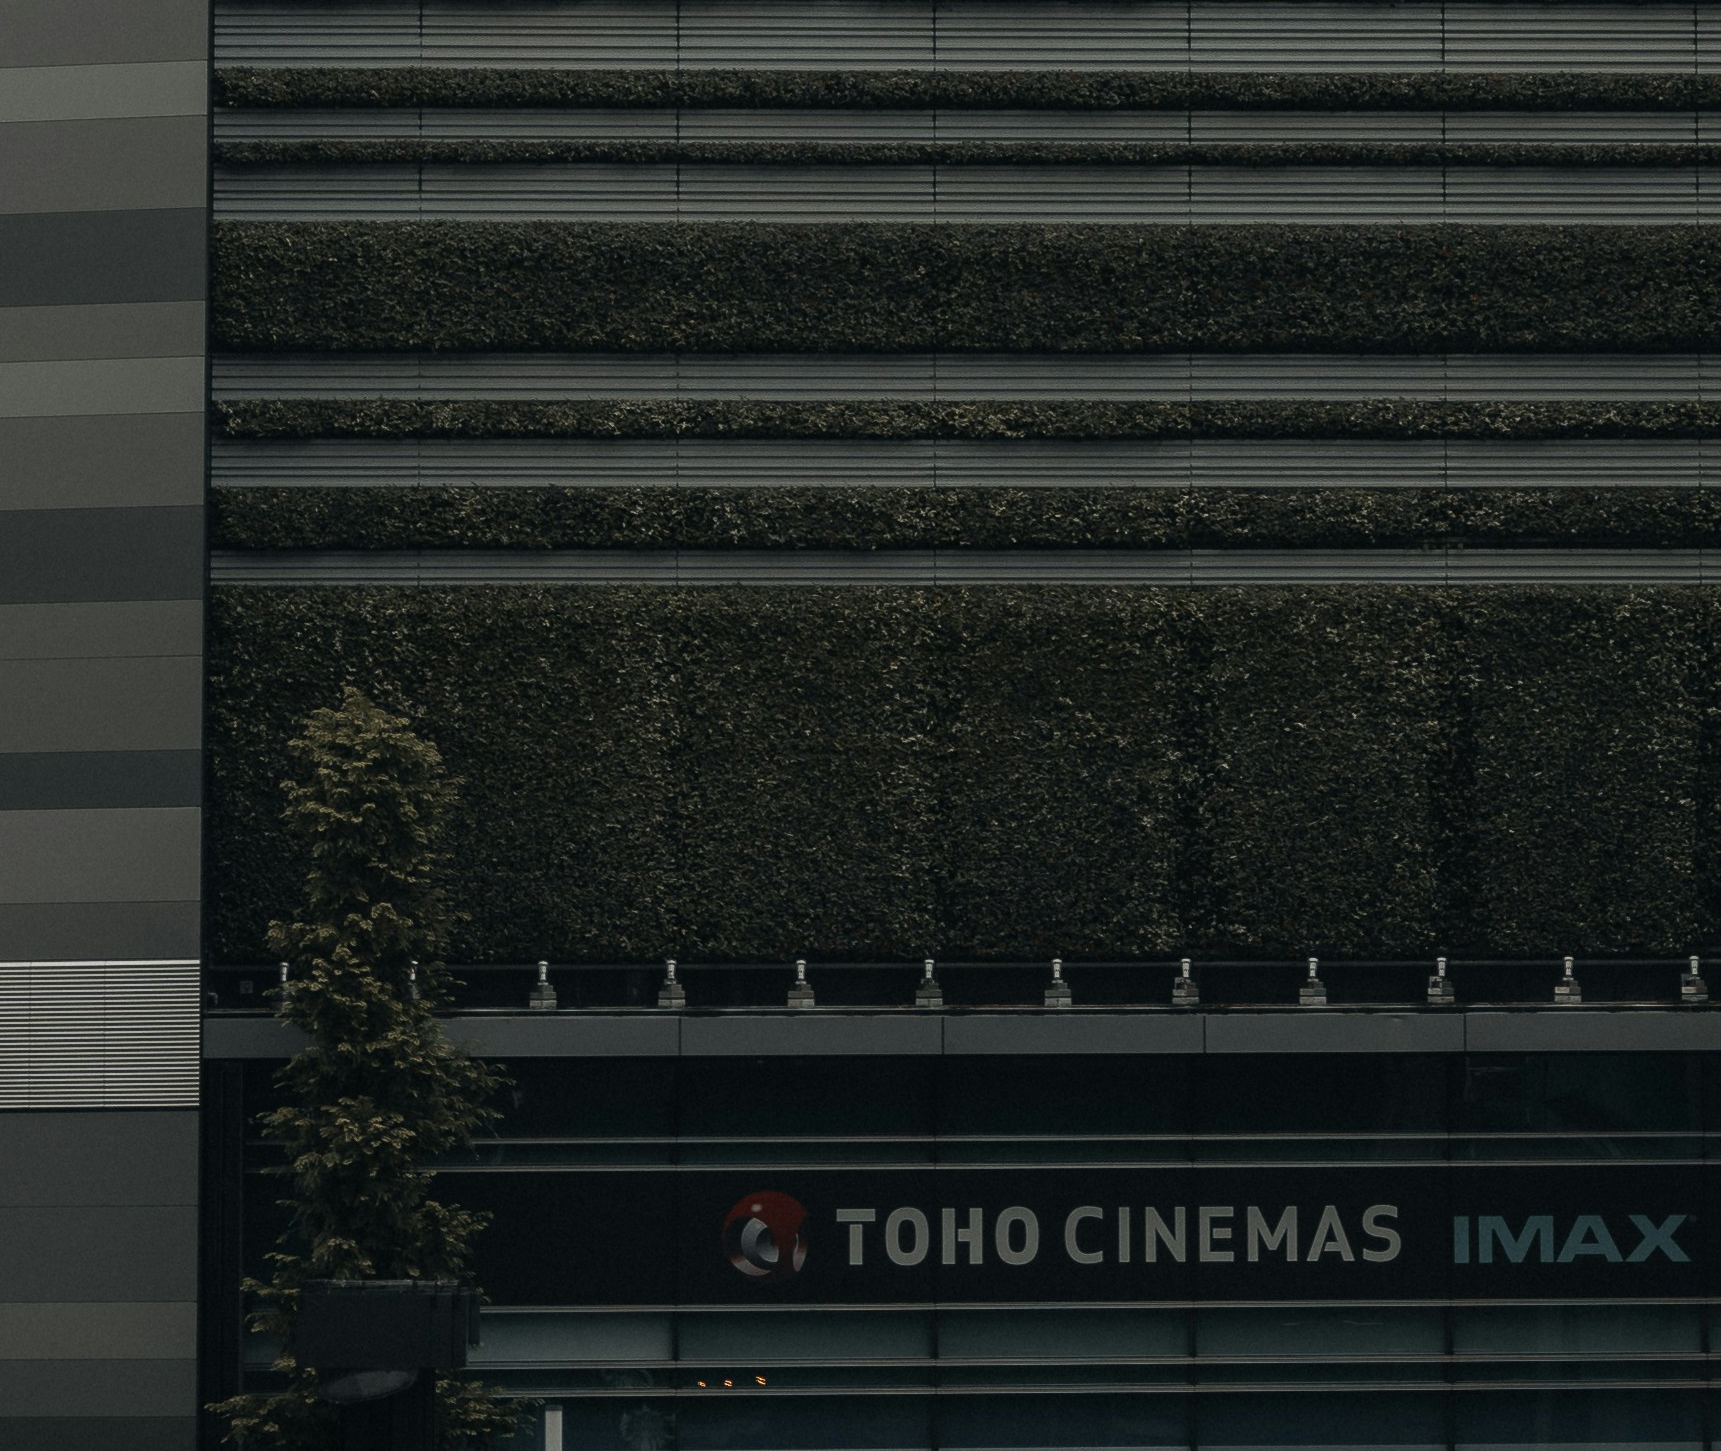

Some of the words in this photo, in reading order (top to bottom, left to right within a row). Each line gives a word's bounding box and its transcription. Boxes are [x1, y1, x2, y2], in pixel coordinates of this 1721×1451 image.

[836, 1205, 1040, 1268] TOHO
[1064, 1203, 1402, 1266] CINEMAS
[1452, 1213, 1691, 1265] IMAX
